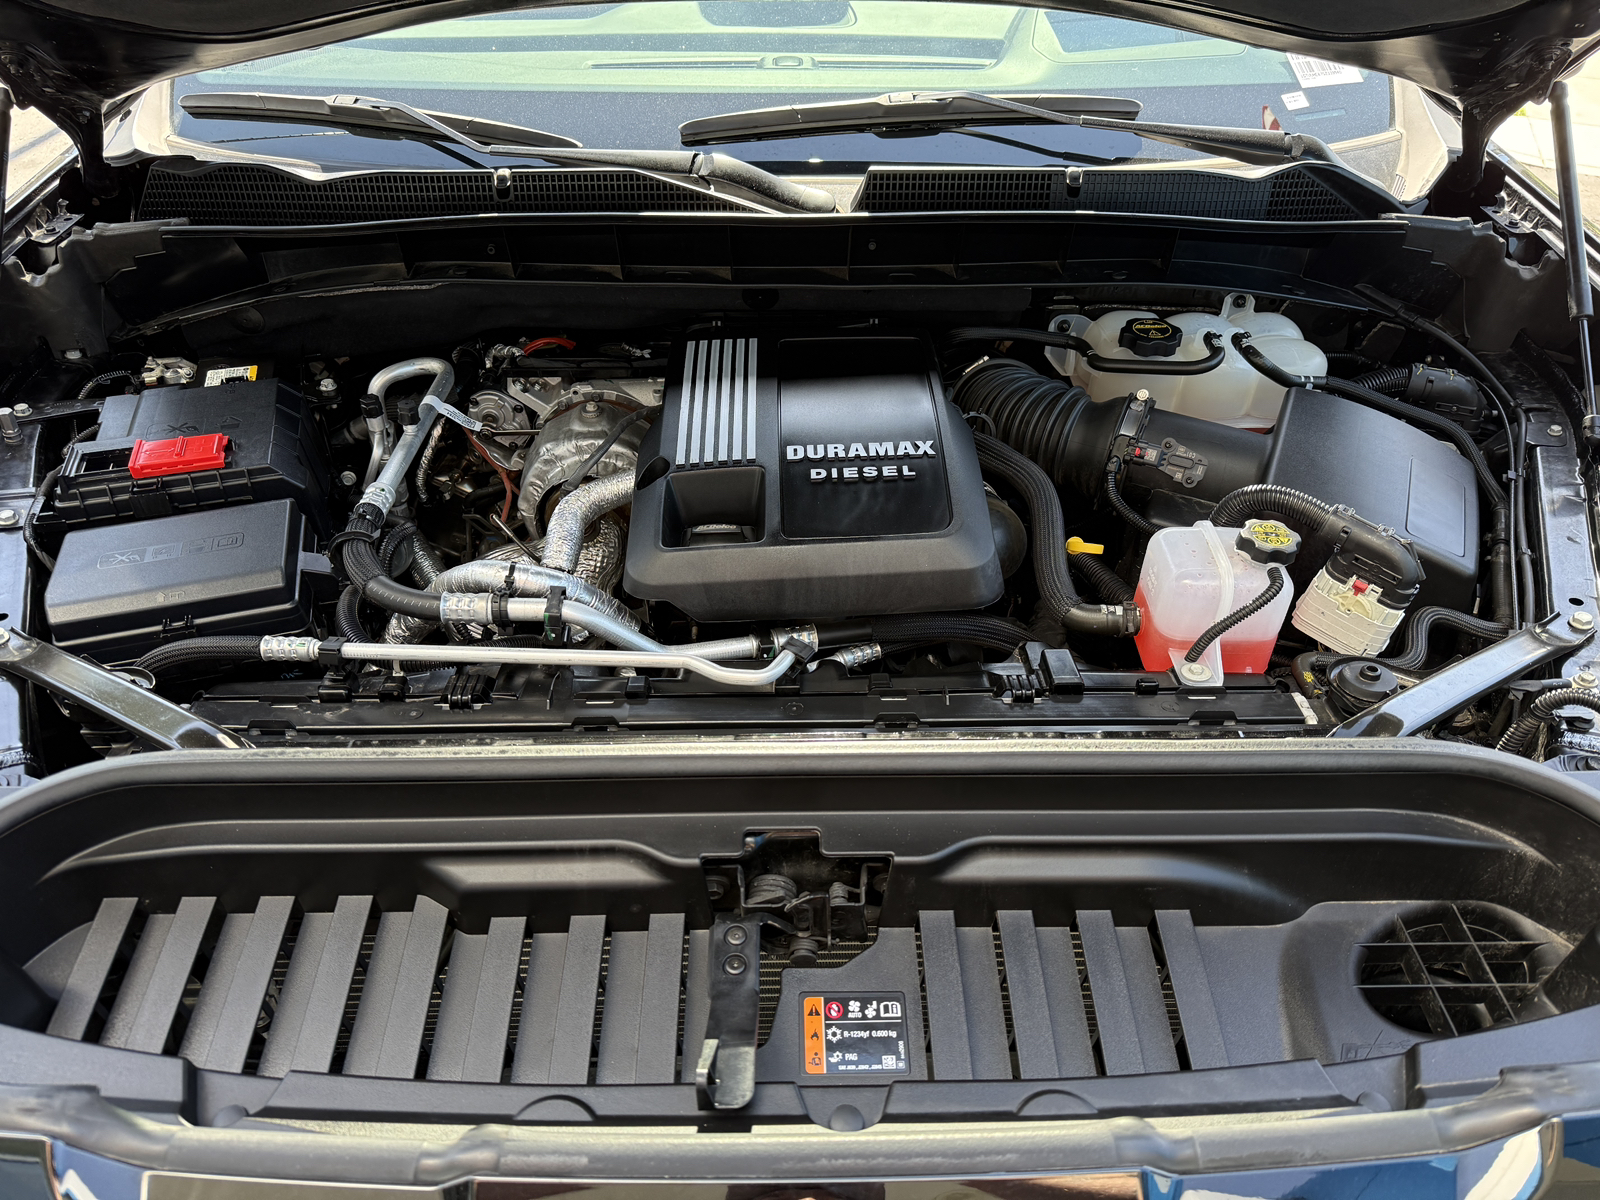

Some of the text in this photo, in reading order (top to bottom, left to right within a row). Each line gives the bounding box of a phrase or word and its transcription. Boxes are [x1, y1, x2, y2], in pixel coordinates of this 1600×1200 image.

[786, 440, 937, 462] DURAMAX
[810, 465, 916, 480] DIESEL
[843, 1030, 870, 1039] R-1234yf
[888, 1030, 897, 1038] kg
[844, 1053, 858, 1061] PAG
